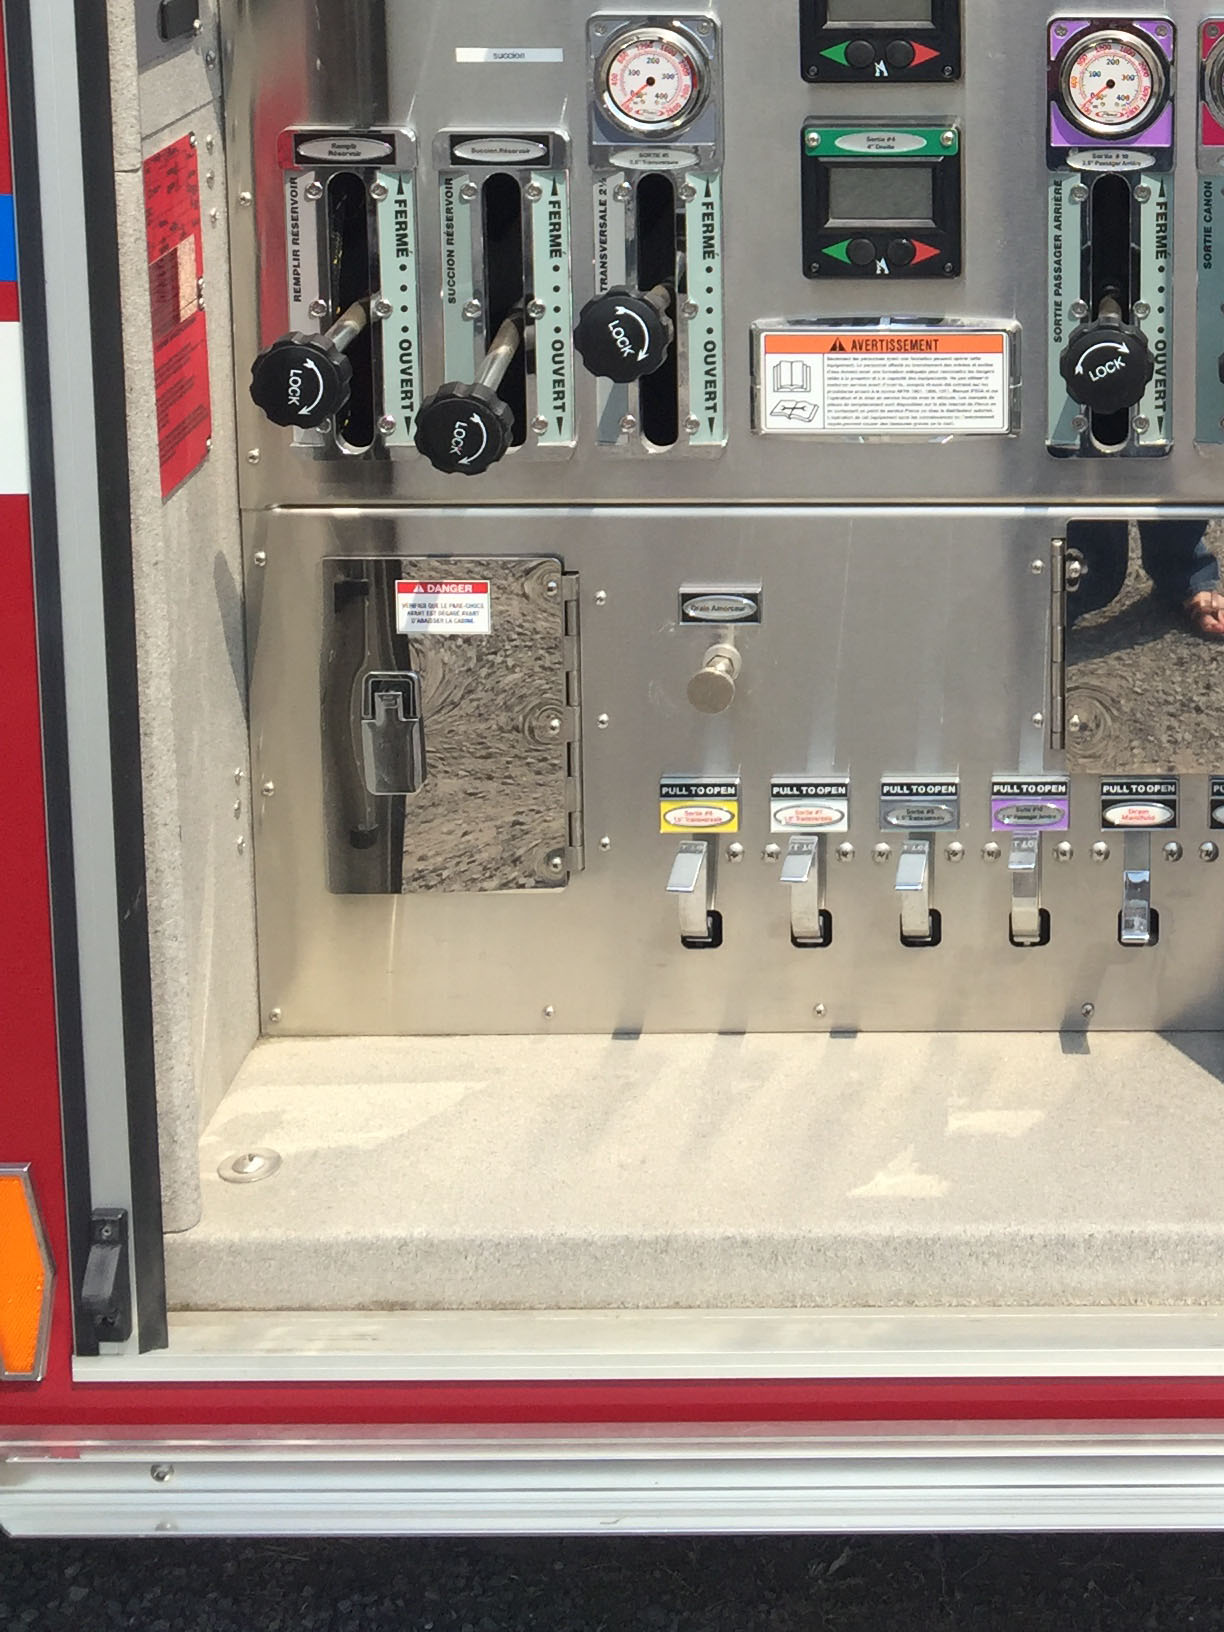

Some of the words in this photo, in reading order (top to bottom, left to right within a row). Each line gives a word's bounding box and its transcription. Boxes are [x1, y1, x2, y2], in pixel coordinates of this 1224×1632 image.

[493, 51, 525, 59] succion
[290, 175, 301, 245] RÉSERVOIR
[444, 177, 455, 248] RÉSERVOIR
[1054, 179, 1063, 232] ARRIÈRE
[1203, 181, 1212, 223] CANON
[394, 199, 413, 258] FERMÉ
[549, 200, 566, 258] FERMÉ
[600, 198, 609, 292] TRANSVERSALE
[701, 201, 720, 260] FERMÉ
[1155, 201, 1171, 260] FERMÉ
[1203, 224, 1212, 269] SORTIE
[292, 250, 301, 303] REMPLIR
[447, 252, 456, 304] SUCCION
[1054, 236, 1062, 296] PASSAGER
[608, 319, 636, 357] LOCK
[851, 339, 940, 352] AVERTISSEMENT
[1053, 300, 1062, 343] SORTIE
[288, 369, 302, 406] LOCK
[399, 339, 414, 412] OUVERT
[551, 339, 566, 413] OUVERT
[704, 339, 717, 414] OUVERT
[1089, 356, 1126, 382] LOCK
[1154, 340, 1167, 412] OUVERT
[449, 421, 468, 455] LOCK
[427, 584, 473, 593] DANGER
[883, 785, 909, 793] PULL
[911, 785, 925, 793] TO
[927, 785, 956, 793] OPEN
[994, 785, 1019, 793] PULL
[1021, 785, 1036, 793] TO
[1037, 785, 1066, 793] OPEN
[1103, 785, 1129, 793] PULL
[1130, 785, 1145, 793] TO
[1147, 785, 1175, 793] OPEN
